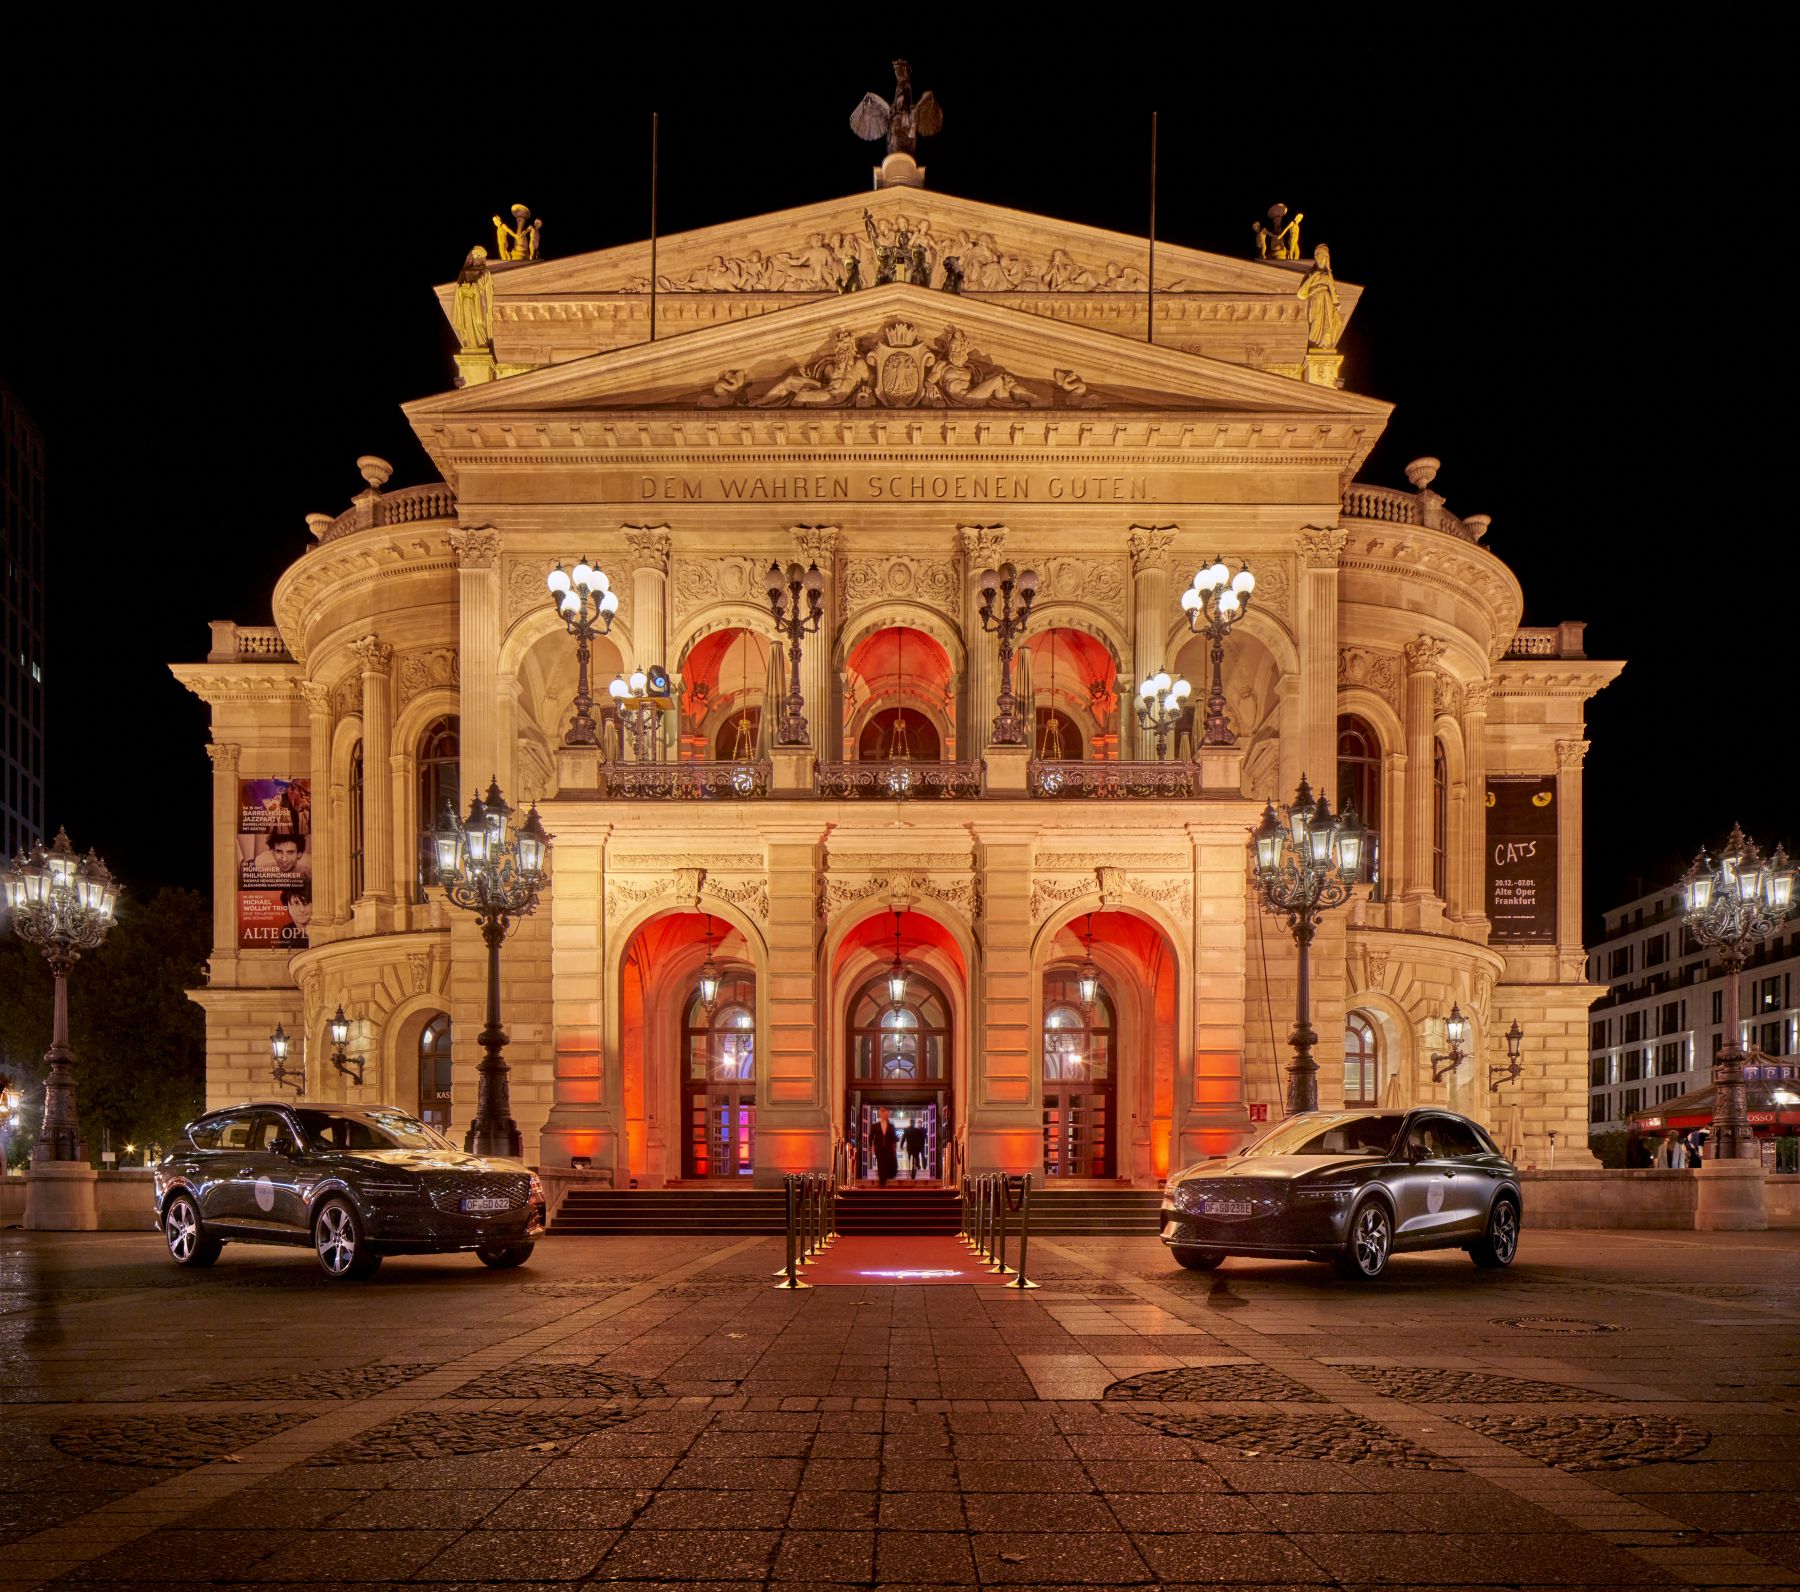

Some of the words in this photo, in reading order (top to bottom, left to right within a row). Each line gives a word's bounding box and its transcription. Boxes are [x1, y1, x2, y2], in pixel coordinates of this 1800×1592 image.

[641, 475, 703, 499] DEM
[719, 475, 849, 499] WAHREN
[868, 475, 1029, 499] SCHOENEN
[1049, 475, 1158, 500] GUTEN.
[1495, 840, 1536, 866] CATS
[1516, 888, 1536, 897] Oper
[243, 928, 279, 939] ALTE
